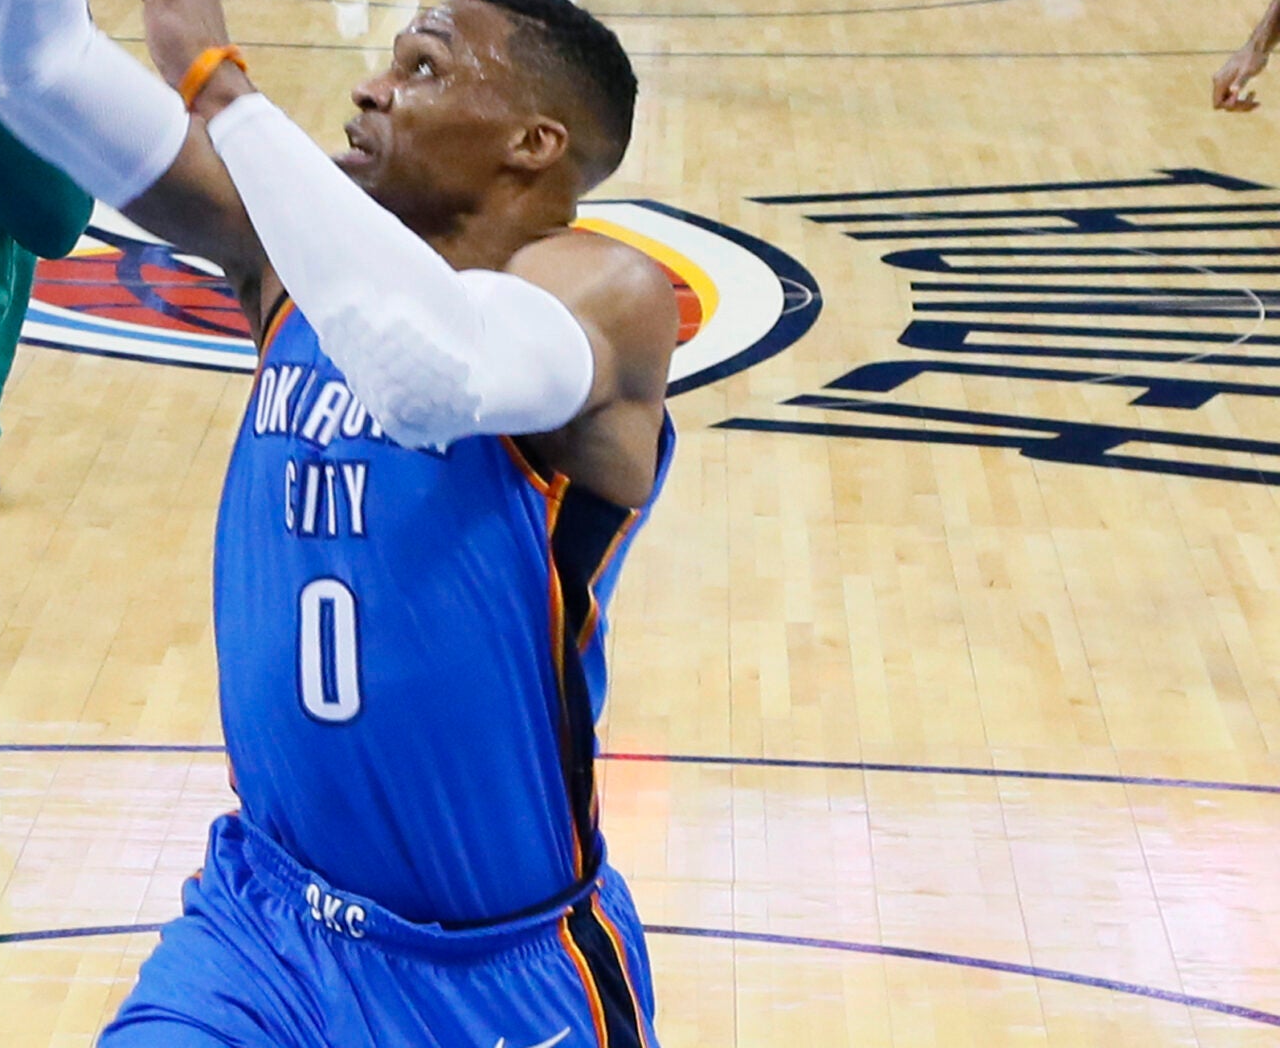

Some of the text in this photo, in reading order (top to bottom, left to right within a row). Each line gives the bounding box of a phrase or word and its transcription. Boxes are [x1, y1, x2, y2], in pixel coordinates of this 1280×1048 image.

[285, 460, 366, 536] CITY
[300, 578, 362, 722] 0
[306, 883, 365, 938] OKC
